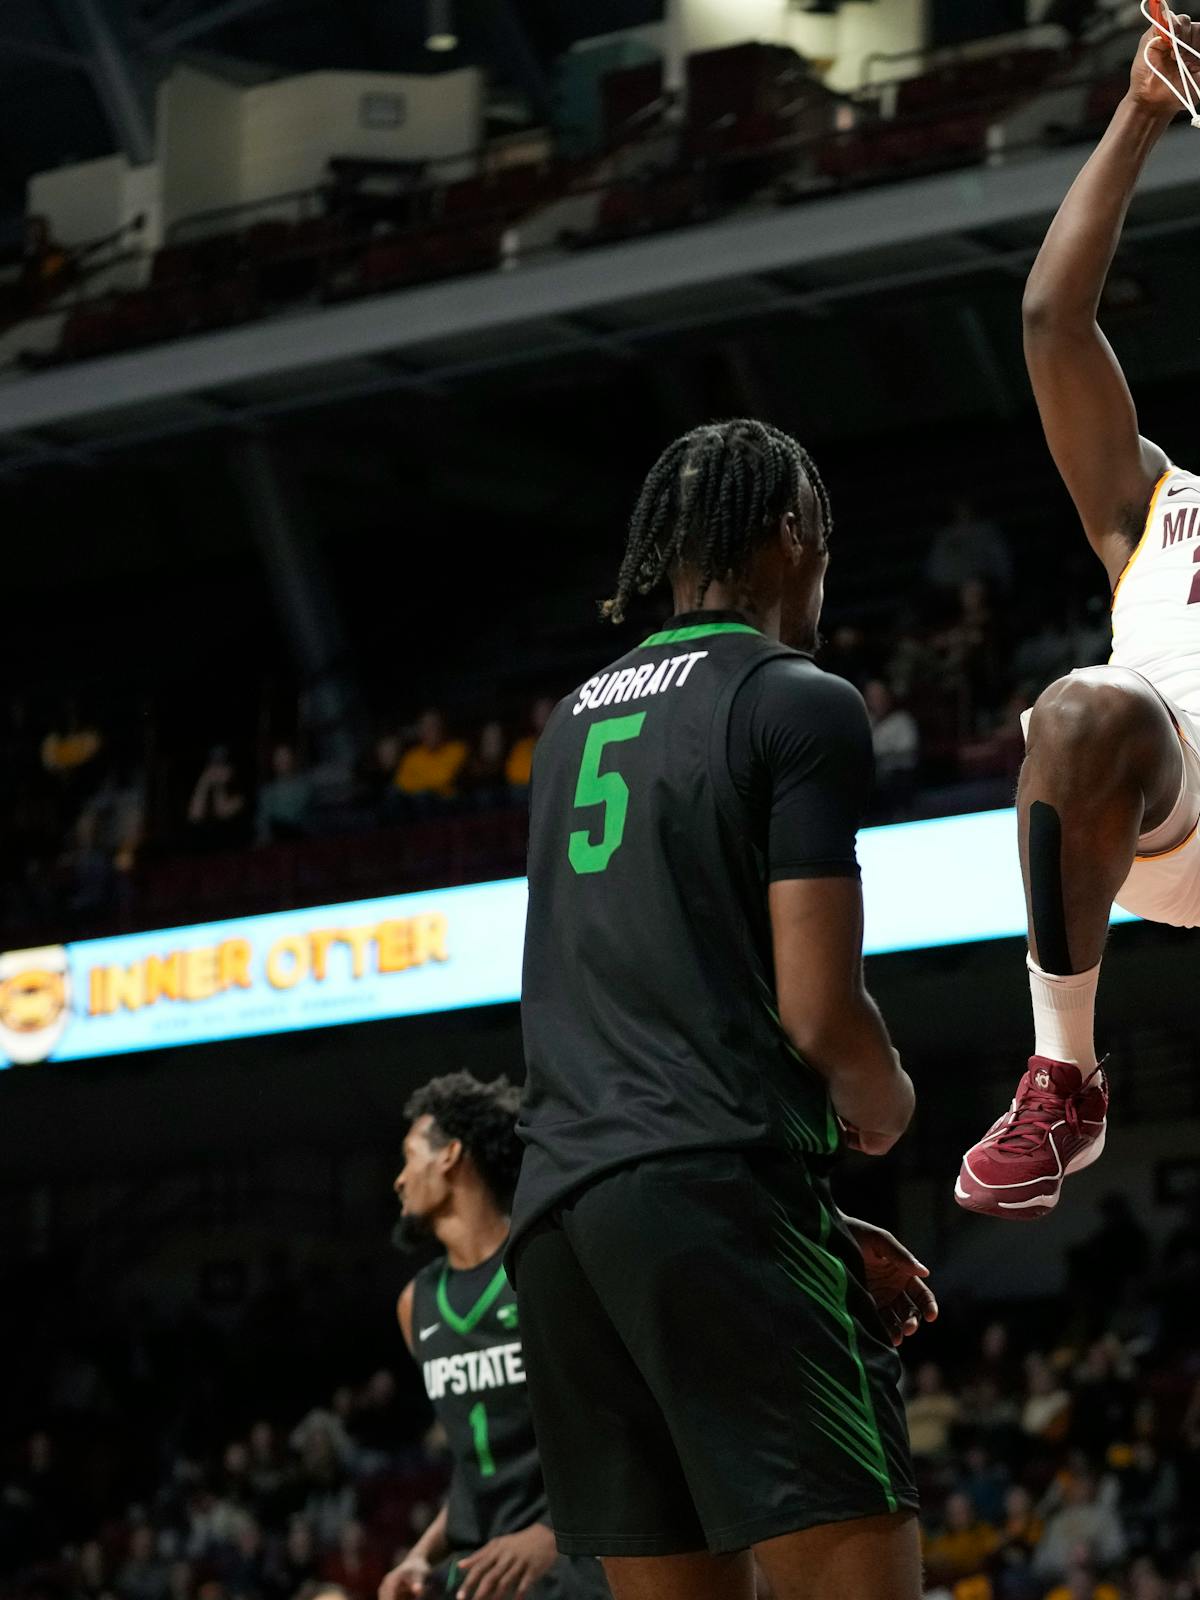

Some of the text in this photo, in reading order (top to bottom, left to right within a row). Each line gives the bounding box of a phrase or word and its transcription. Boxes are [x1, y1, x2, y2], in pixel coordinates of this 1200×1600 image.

[573, 650, 708, 716] SURRATT
[567, 711, 647, 874] 5
[88, 938, 250, 1015] INNER
[267, 912, 448, 989] OTTER
[423, 1342, 526, 1399] UPSTATE
[470, 1402, 496, 1476] 1
